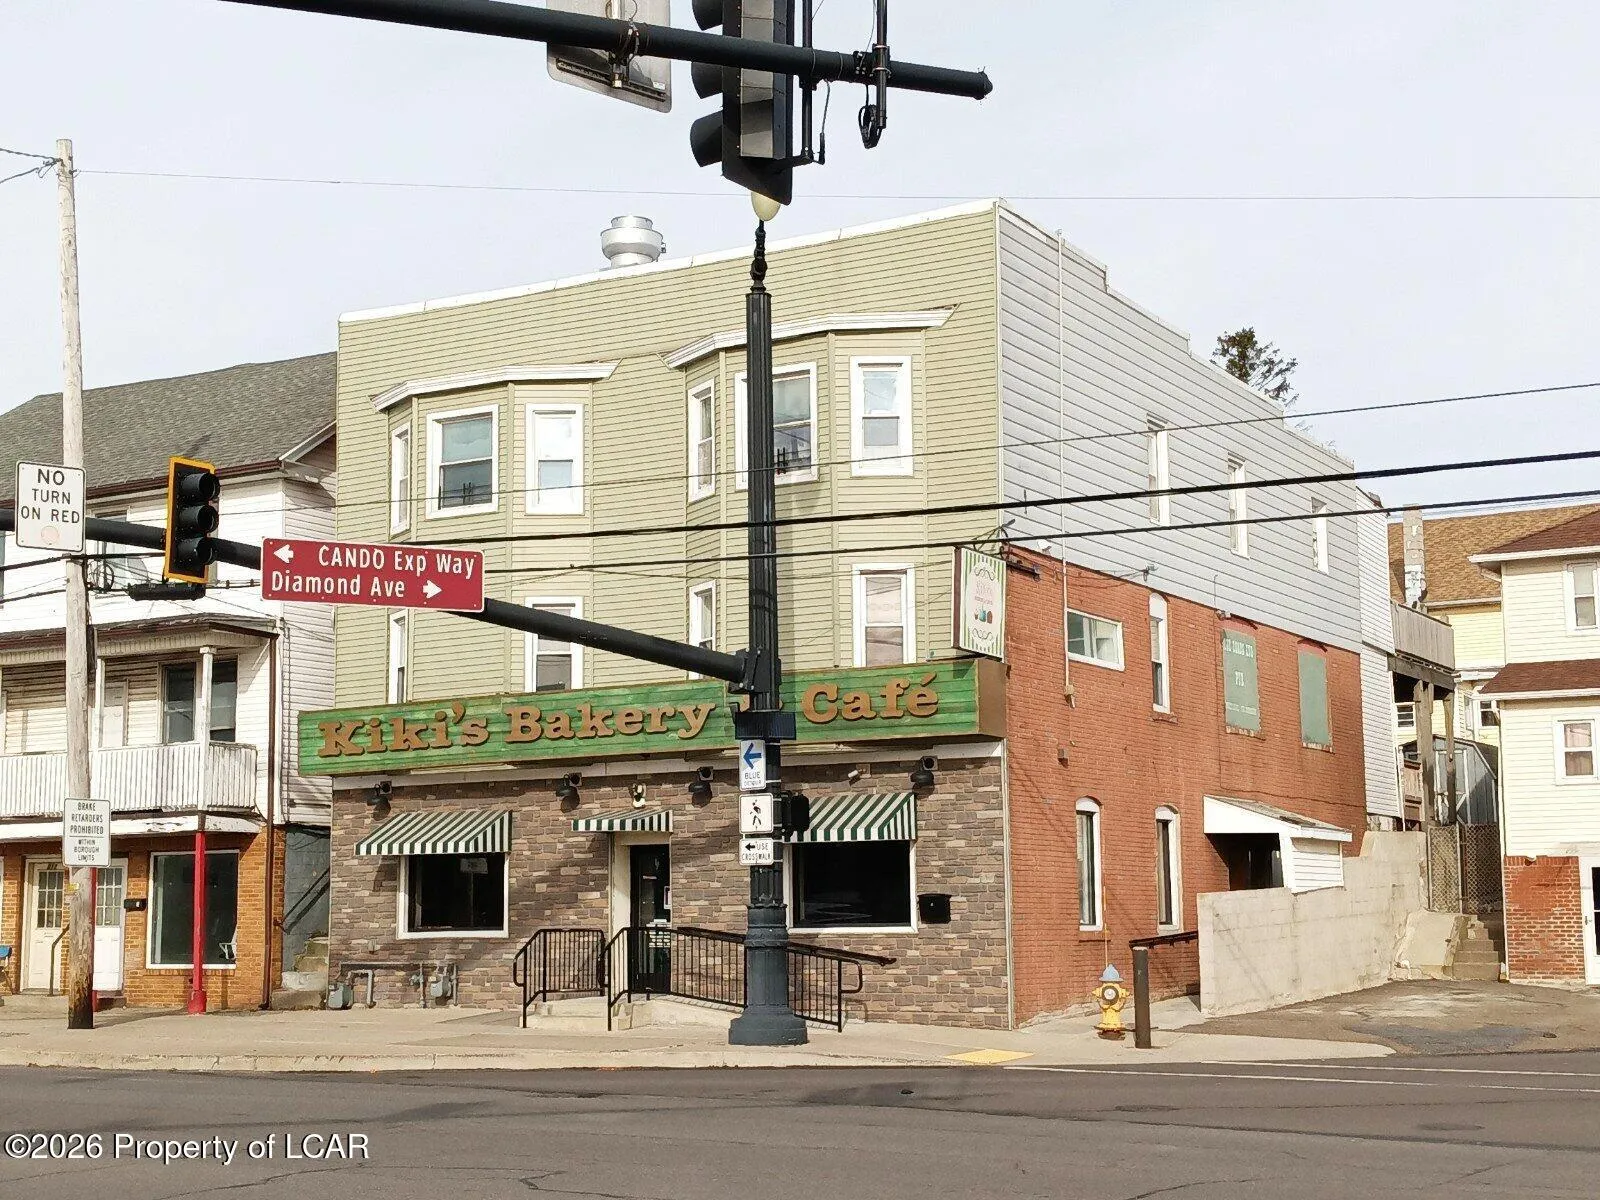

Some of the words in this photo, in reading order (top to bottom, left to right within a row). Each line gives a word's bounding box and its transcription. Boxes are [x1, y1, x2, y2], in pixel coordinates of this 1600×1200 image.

[37, 468, 65, 486] NO
[32, 488, 71, 505] TURN
[21, 505, 41, 520] ON
[51, 508, 80, 524] RED
[318, 544, 385, 570] CANDO
[394, 550, 427, 577] Exp
[436, 553, 475, 580] Way
[271, 569, 361, 596] Diamond
[370, 576, 405, 598] Ave
[317, 700, 491, 758] Kiki's
[504, 701, 716, 744] Bakery
[800, 671, 939, 725] Café
[744, 771, 761, 780] BLUE
[77, 801, 96, 812] BRAKE
[71, 813, 103, 823] RETARDERS
[70, 824, 104, 835] PROHIBITED
[78, 838, 96, 846] WITHIN
[756, 842, 769, 851] USE
[74, 846, 100, 854] BOROUGH
[741, 852, 771, 861] CROSSWALK
